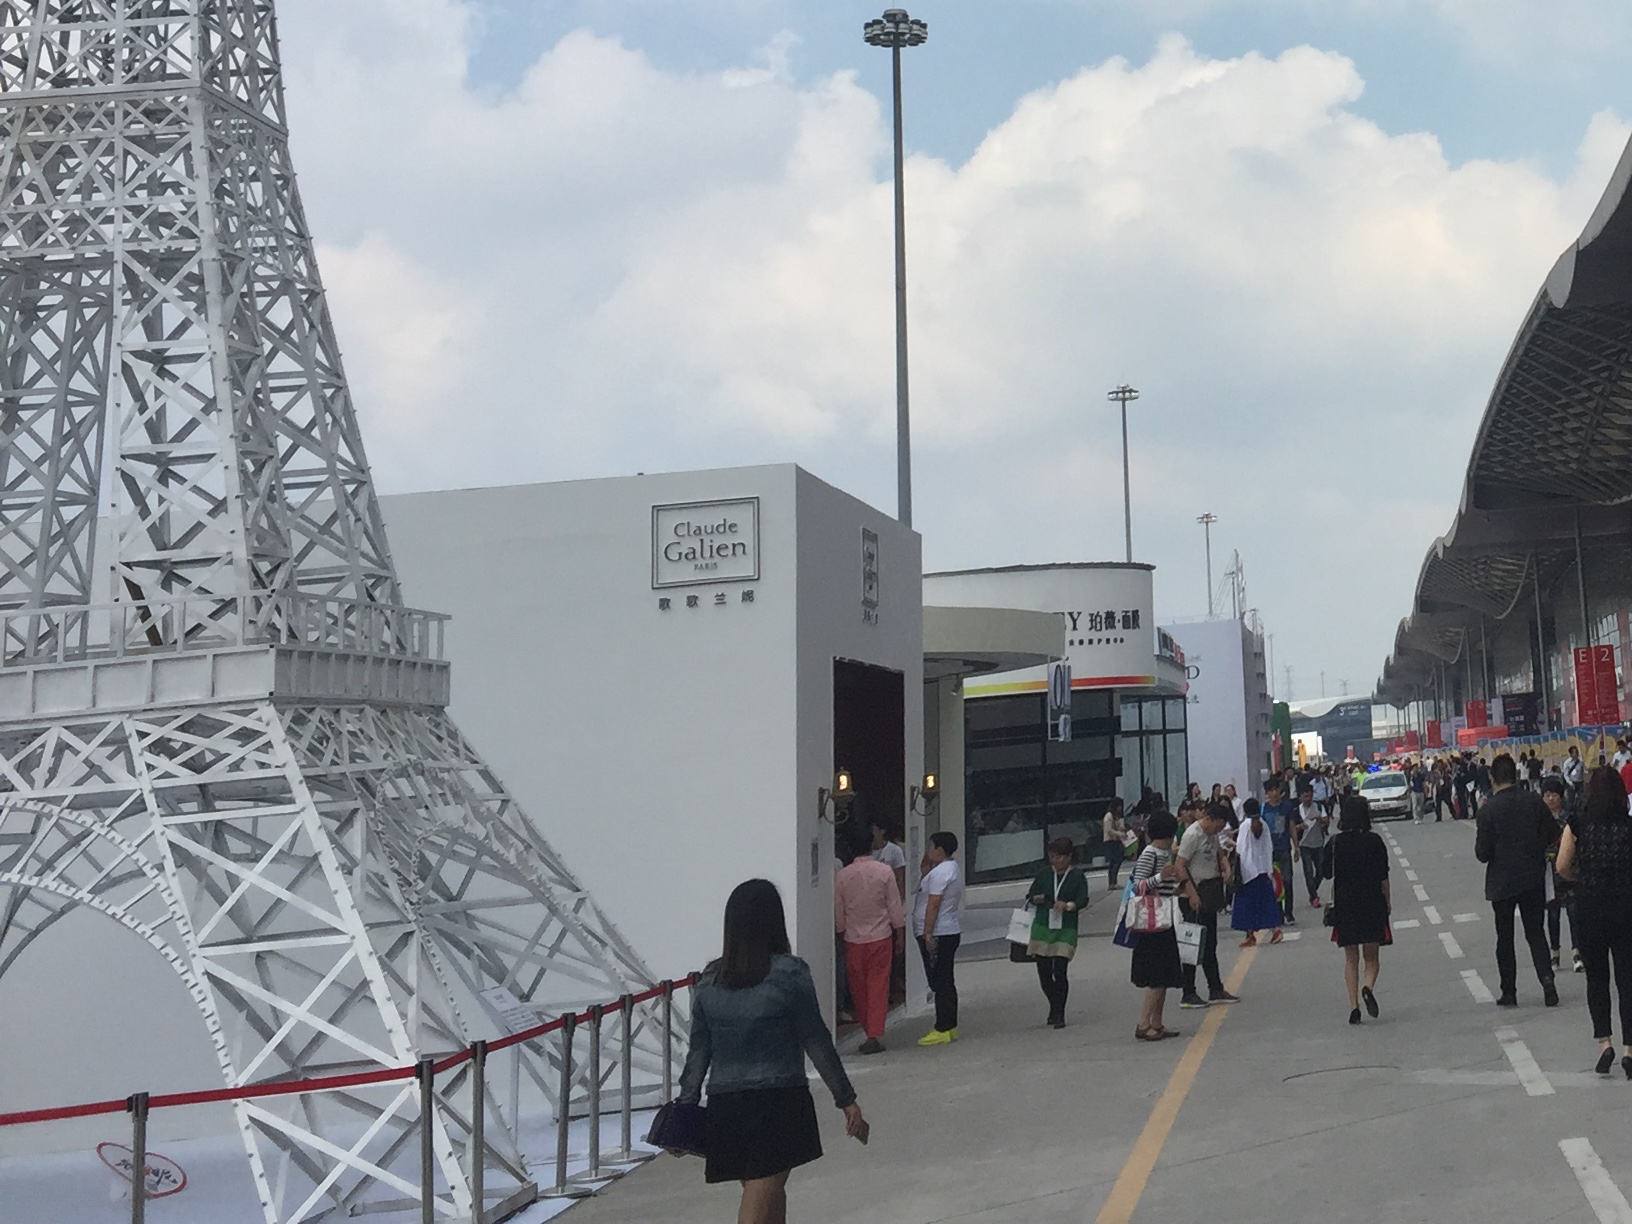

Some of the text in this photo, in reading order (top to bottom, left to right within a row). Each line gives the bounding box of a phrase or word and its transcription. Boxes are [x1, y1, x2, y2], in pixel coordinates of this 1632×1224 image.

[673, 518, 738, 537] Claude
[664, 539, 747, 562] Galien
[694, 562, 718, 570] PARIS
